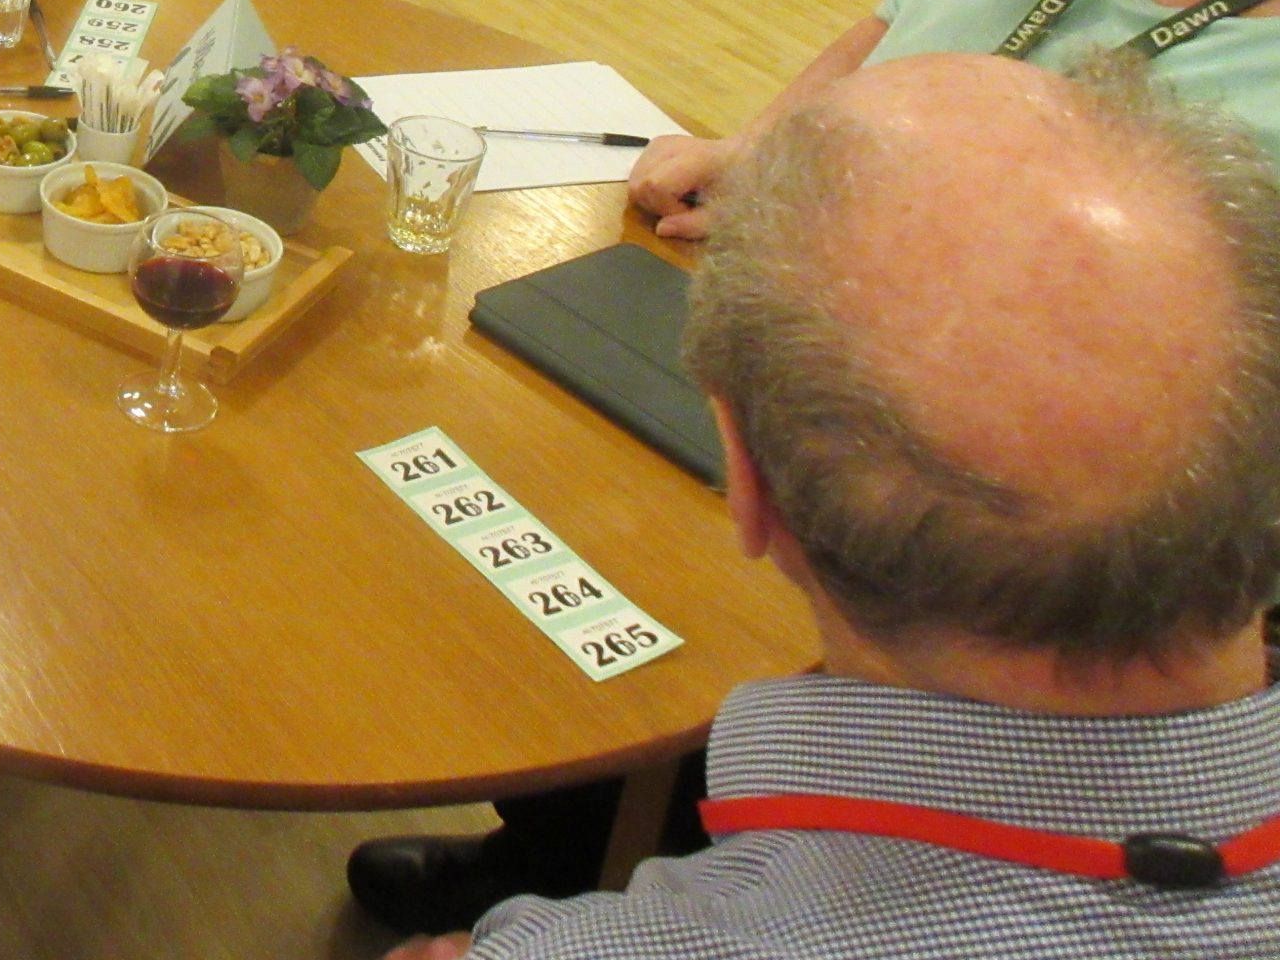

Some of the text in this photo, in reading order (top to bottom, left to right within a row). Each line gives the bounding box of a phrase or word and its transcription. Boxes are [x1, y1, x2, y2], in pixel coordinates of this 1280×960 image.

[87, 18, 138, 32] 259
[96, 0, 147, 15] 260
[1150, 0, 1230, 48] Dawn
[80, 35, 131, 51] 258
[391, 448, 457, 482] 261
[431, 490, 506, 525] 262
[479, 532, 552, 568] 263
[528, 577, 604, 616] 264
[581, 623, 658, 668] 265
